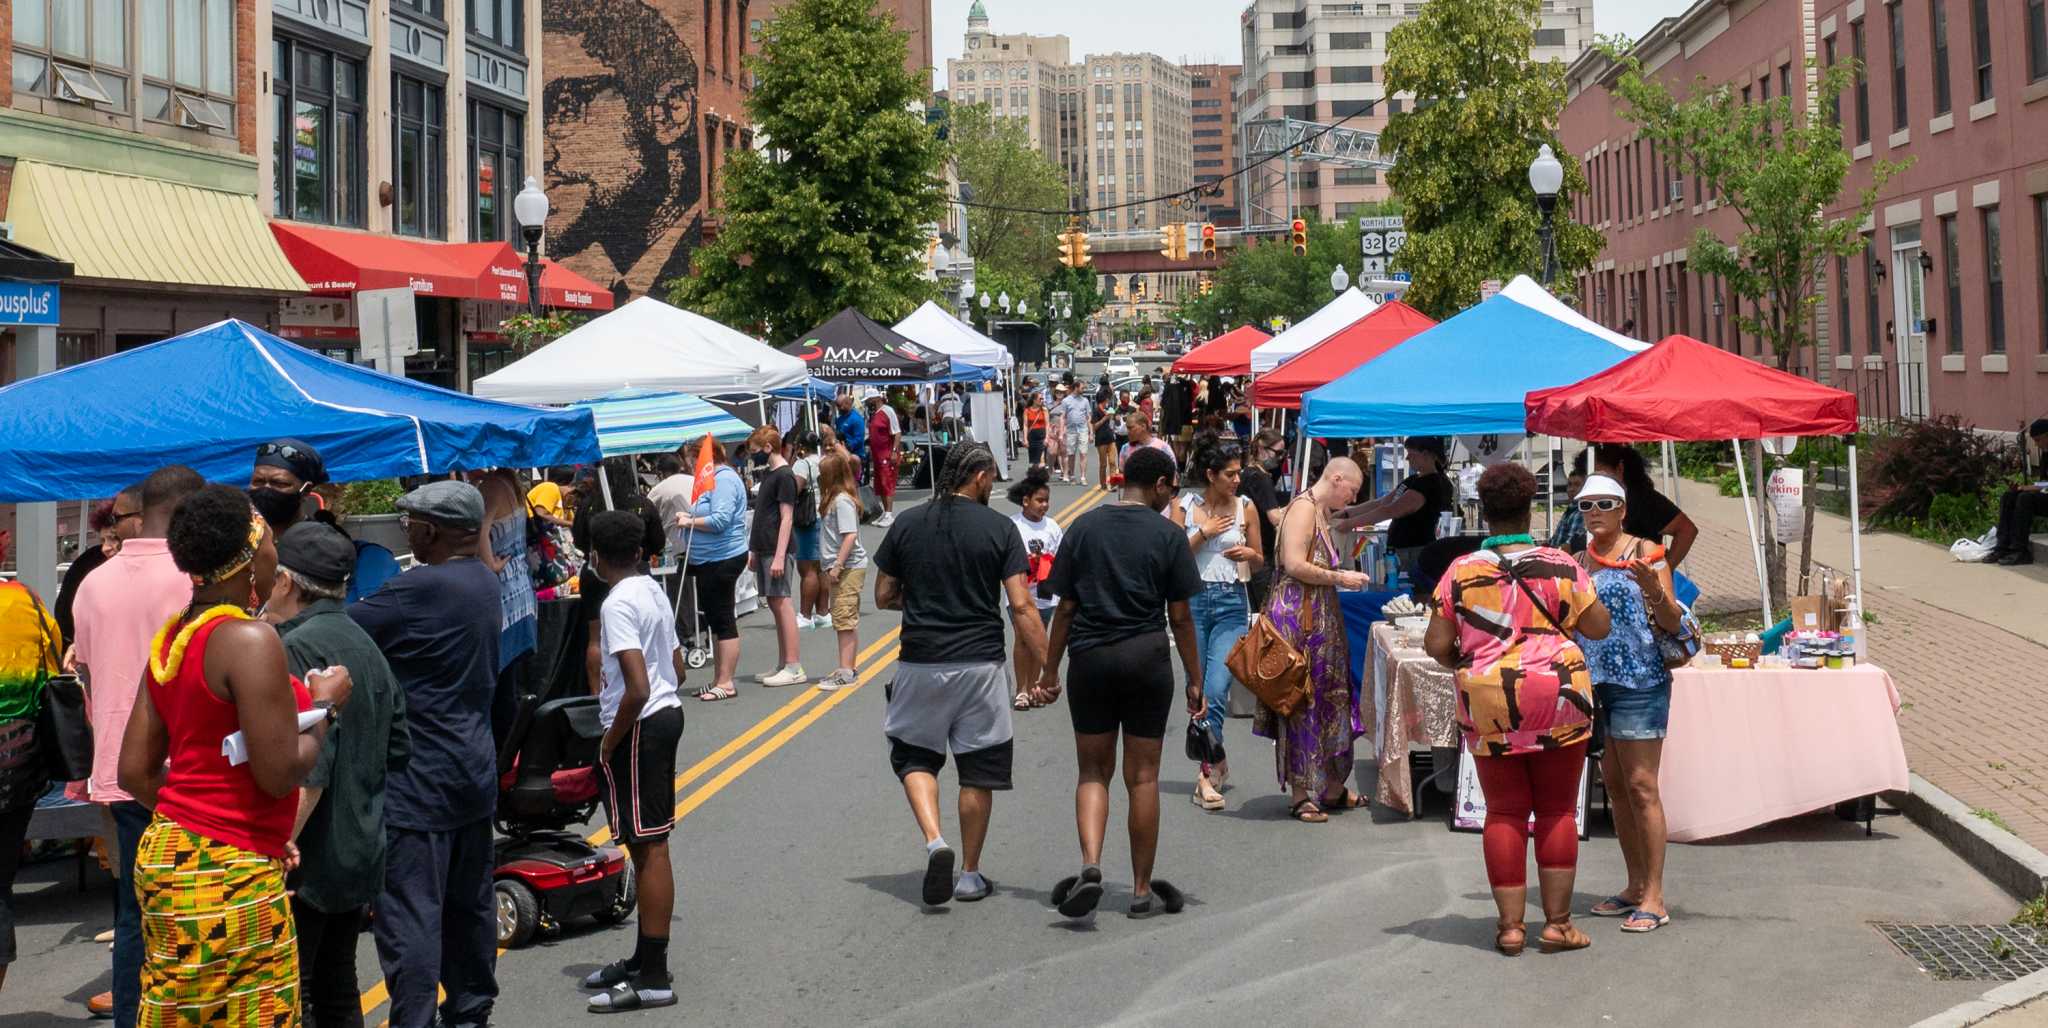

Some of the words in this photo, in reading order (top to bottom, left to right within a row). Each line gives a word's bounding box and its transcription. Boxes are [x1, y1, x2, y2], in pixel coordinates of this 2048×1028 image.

[1361, 219, 1383, 227] NORTH
[1365, 238, 1381, 249] 32
[1389, 236, 1405, 248] 20
[324, 281, 331, 289] &
[331, 281, 357, 290] Beauty
[824, 346, 880, 360] MVP
[1772, 475, 1785, 484] No
